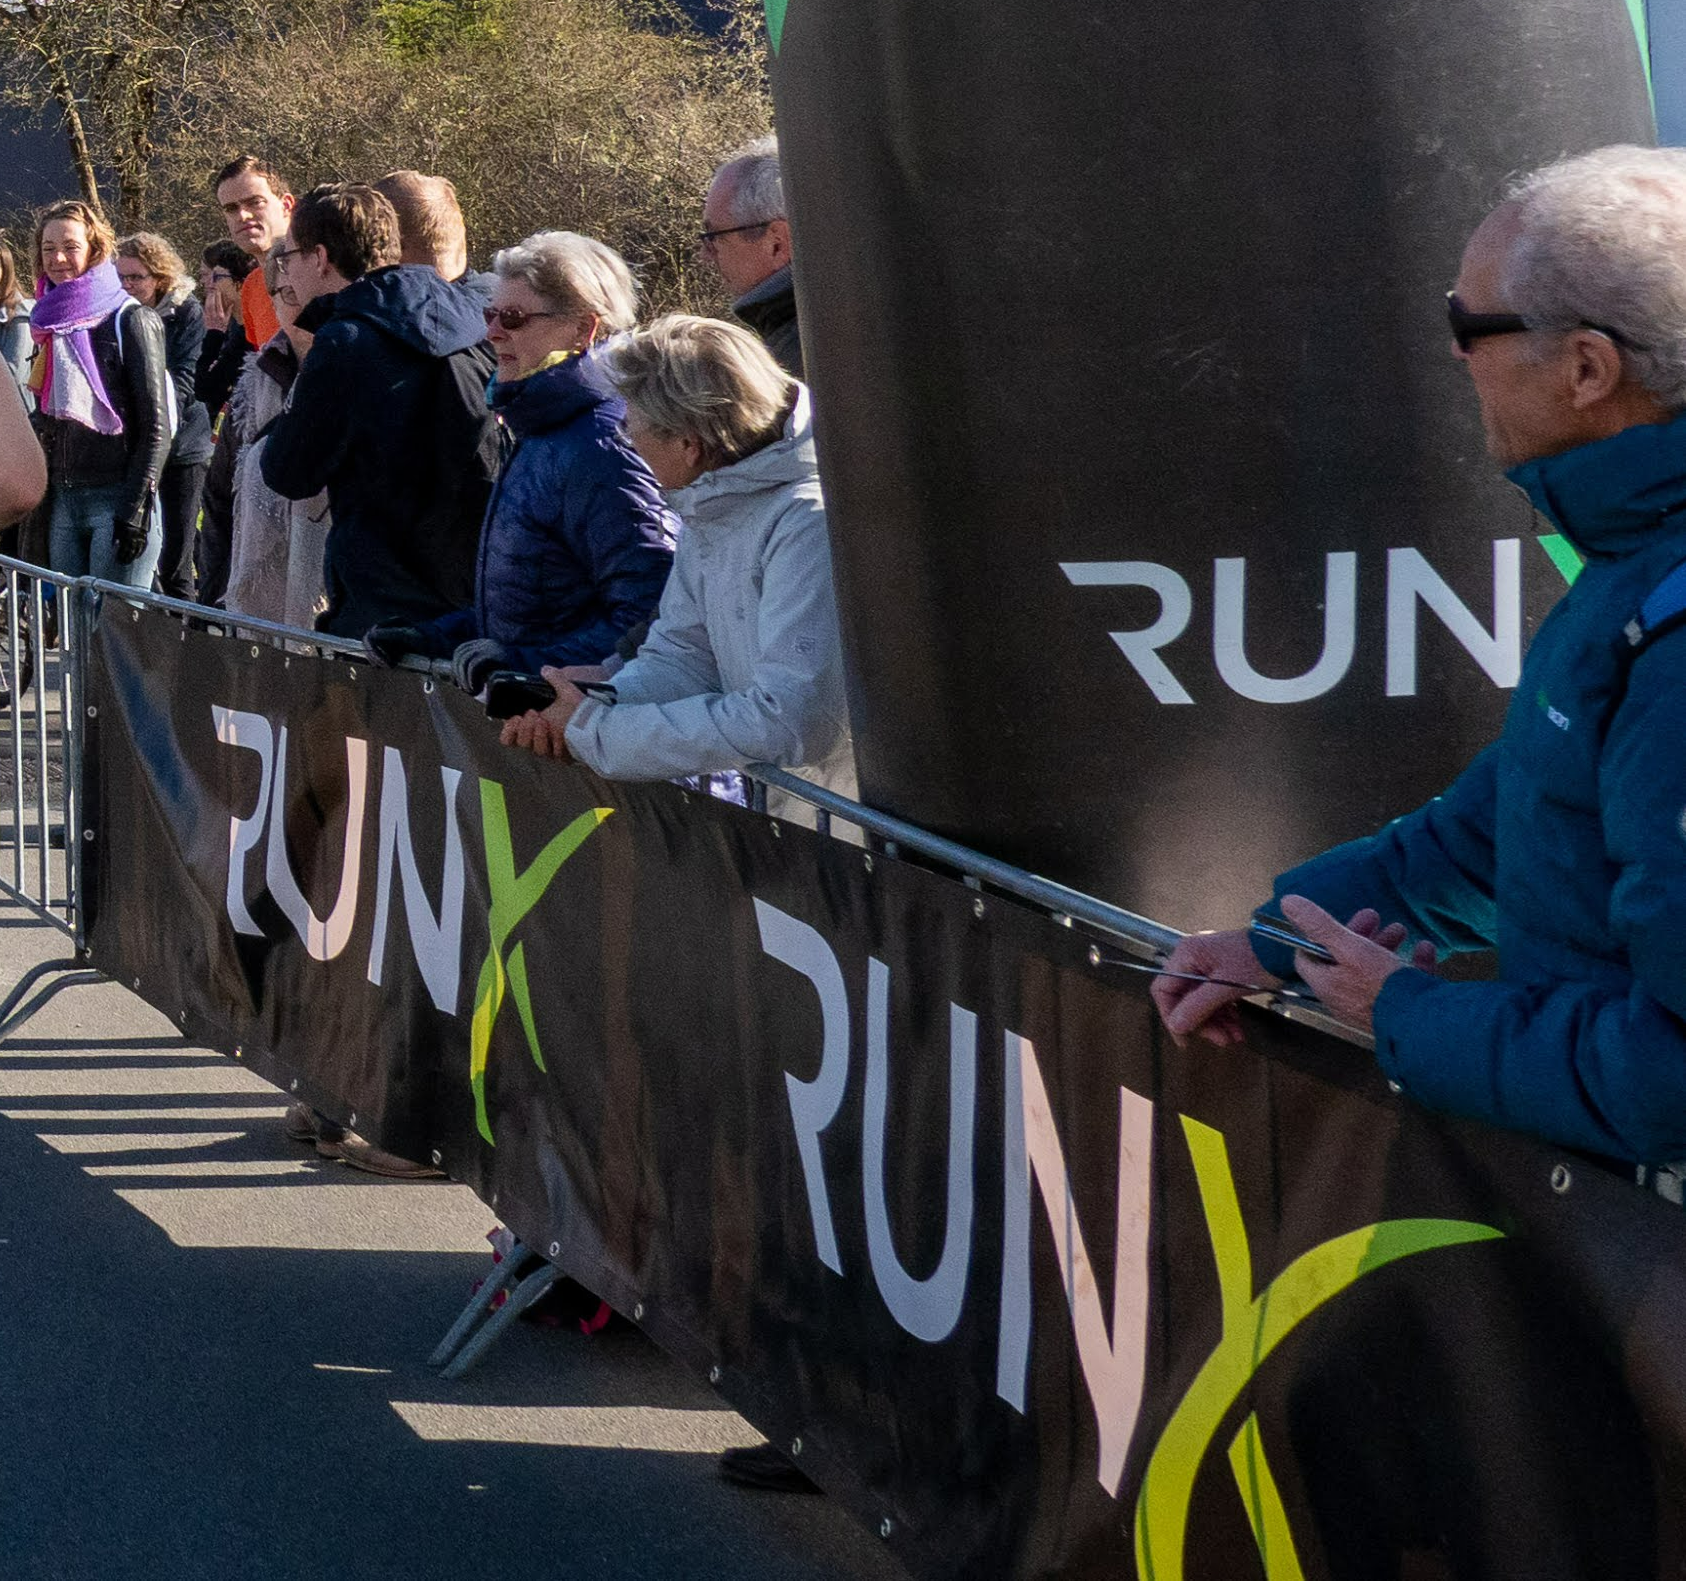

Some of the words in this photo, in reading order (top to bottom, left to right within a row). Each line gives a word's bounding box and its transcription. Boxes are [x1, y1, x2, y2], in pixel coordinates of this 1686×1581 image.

[1058, 534, 1583, 705] RUN
[211, 705, 615, 1146] RUNX
[754, 895, 1507, 1581] RUNX
